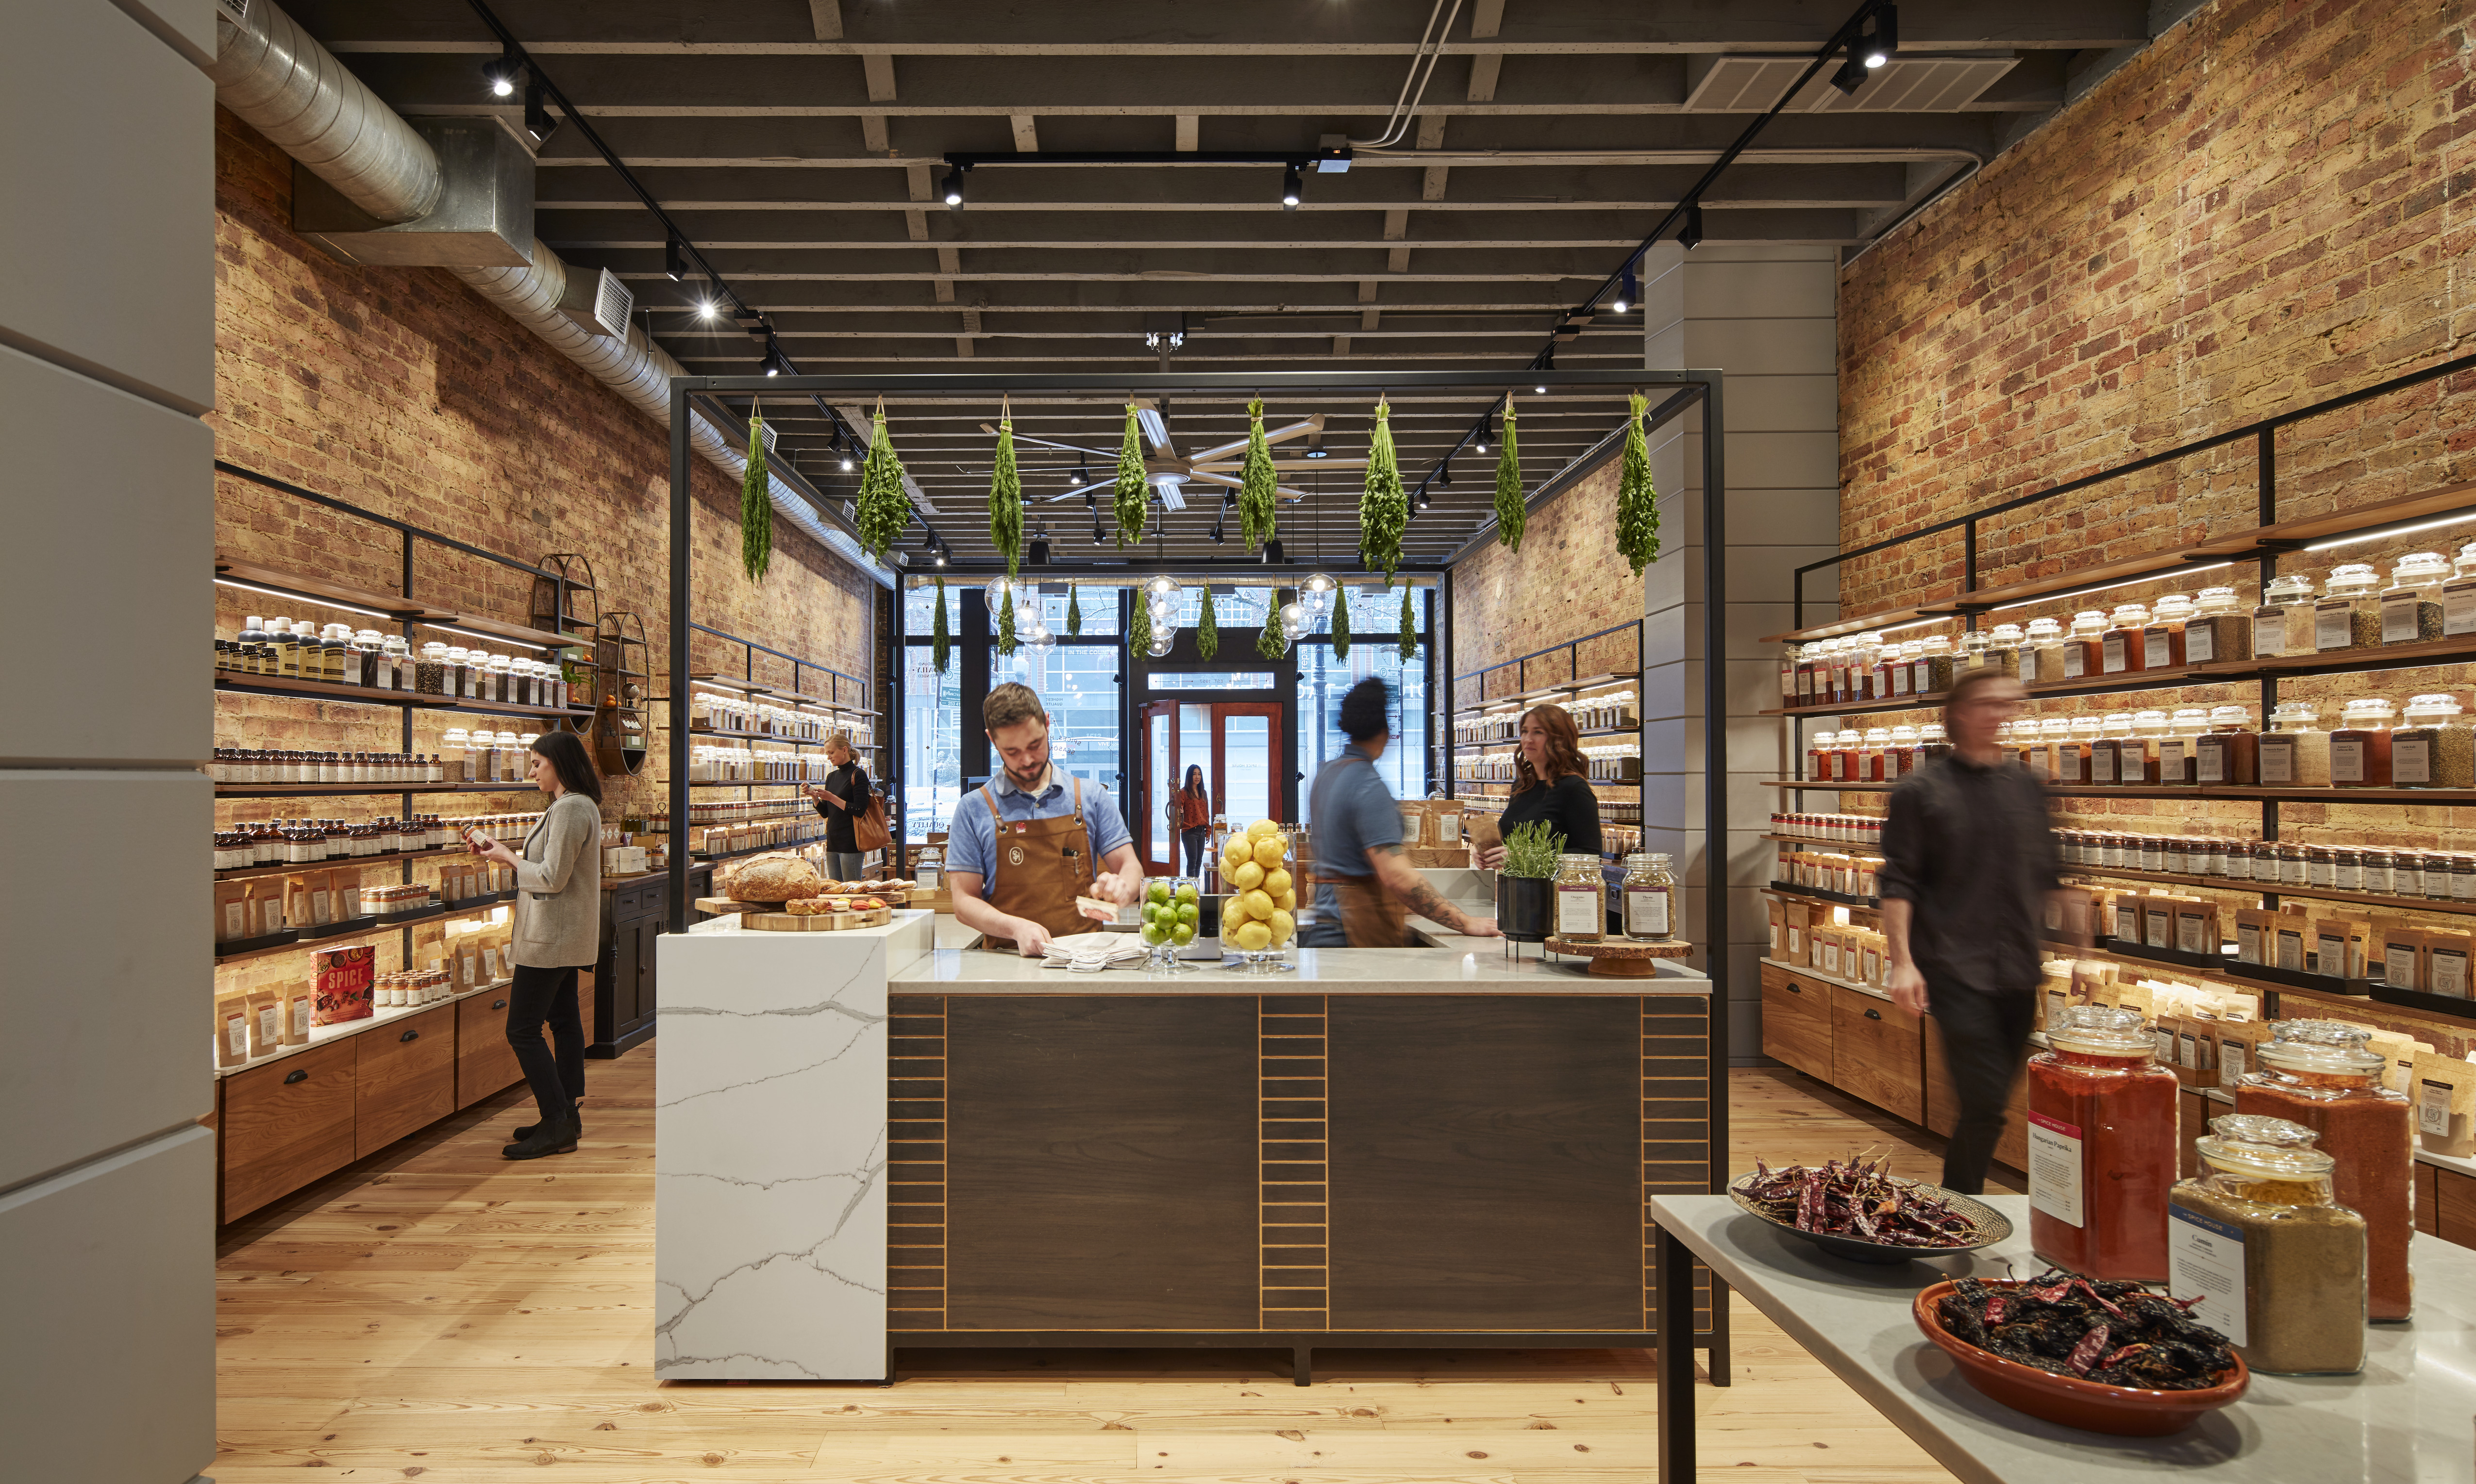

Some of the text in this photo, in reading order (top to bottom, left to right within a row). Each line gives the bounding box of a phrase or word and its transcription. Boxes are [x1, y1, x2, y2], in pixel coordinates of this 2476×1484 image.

[329, 968, 363, 989] SPICE
[2033, 1132, 2072, 1152] Hungarian Paprika
[2188, 1214, 2223, 1231] SPICE HOUSE
[2192, 1234, 2213, 1248] Cumin
